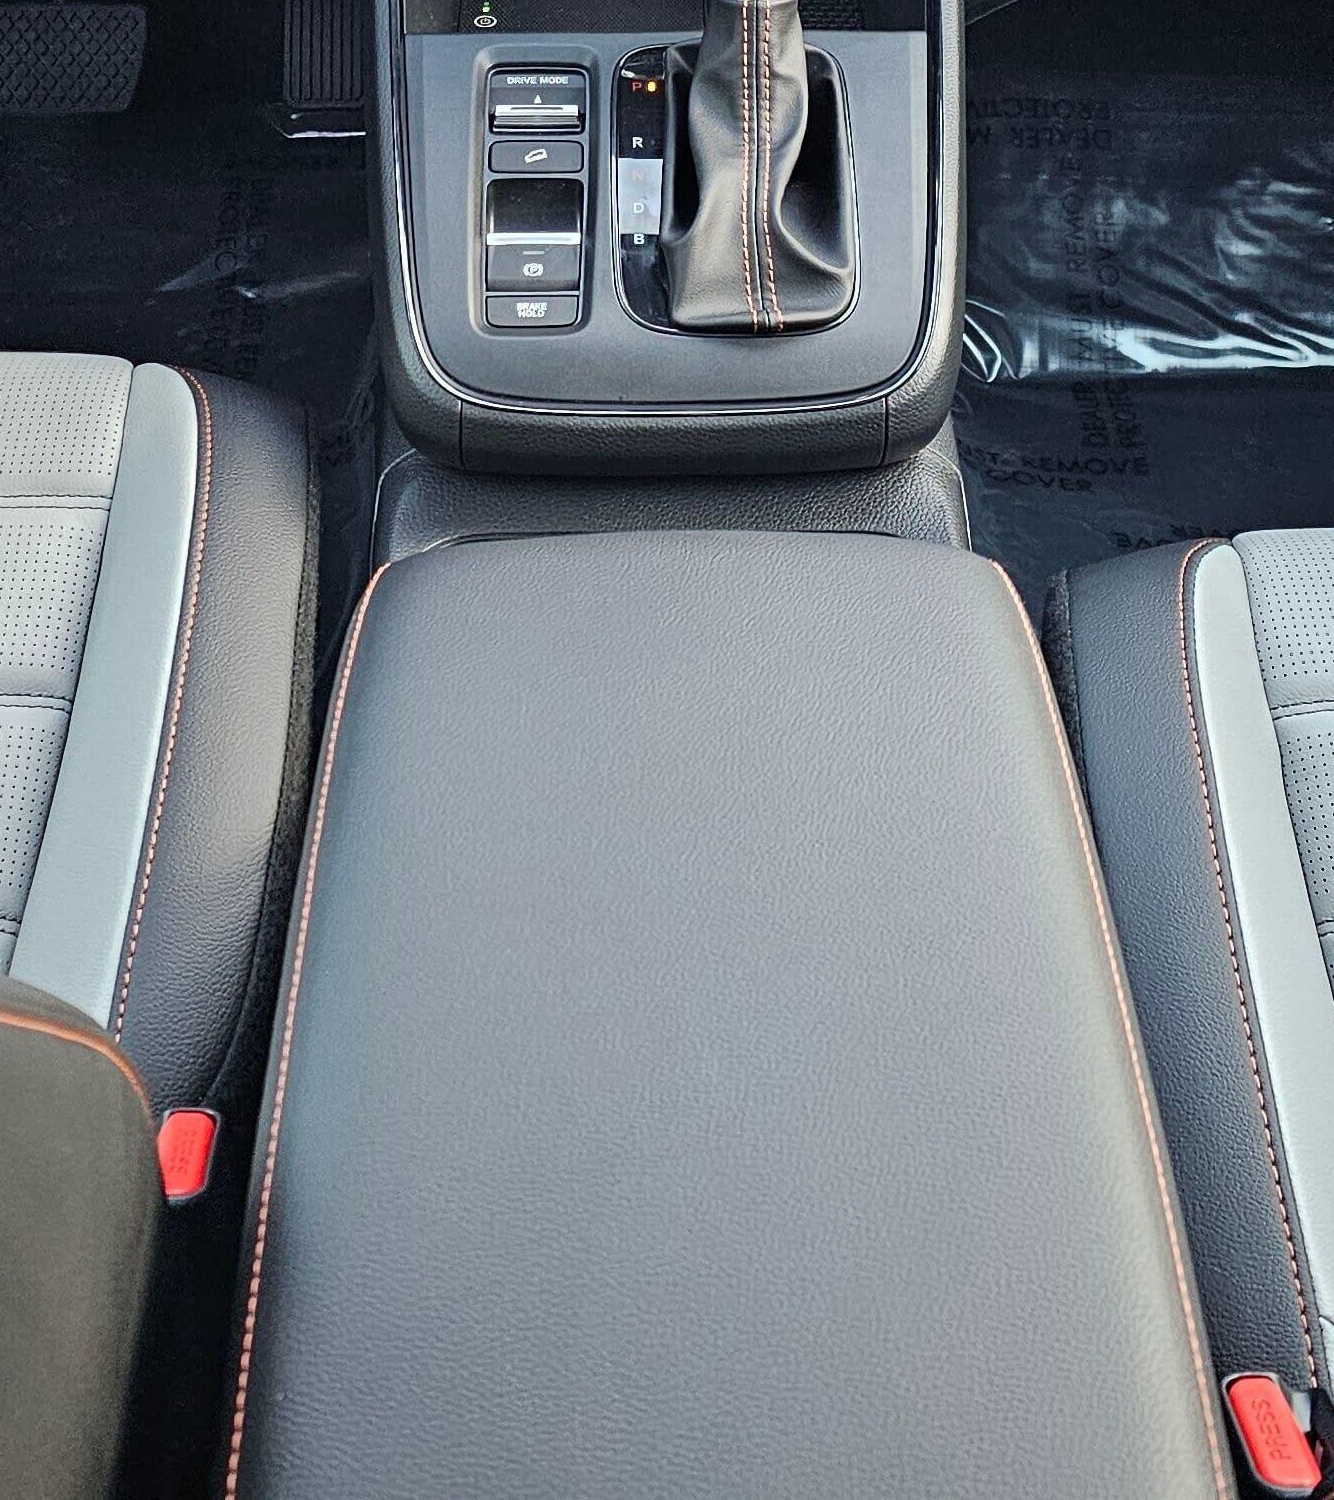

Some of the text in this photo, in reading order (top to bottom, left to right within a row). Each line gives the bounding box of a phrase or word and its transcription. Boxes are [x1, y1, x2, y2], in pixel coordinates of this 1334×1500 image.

[507, 76, 569, 85] DRIVE MODE
[632, 81, 642, 92] P
[632, 136, 643, 149] R
[632, 170, 643, 181] N
[633, 202, 645, 214] D
[633, 233, 645, 245] B
[516, 302, 548, 311] BRAKE
[517, 310, 546, 318] HOLD
